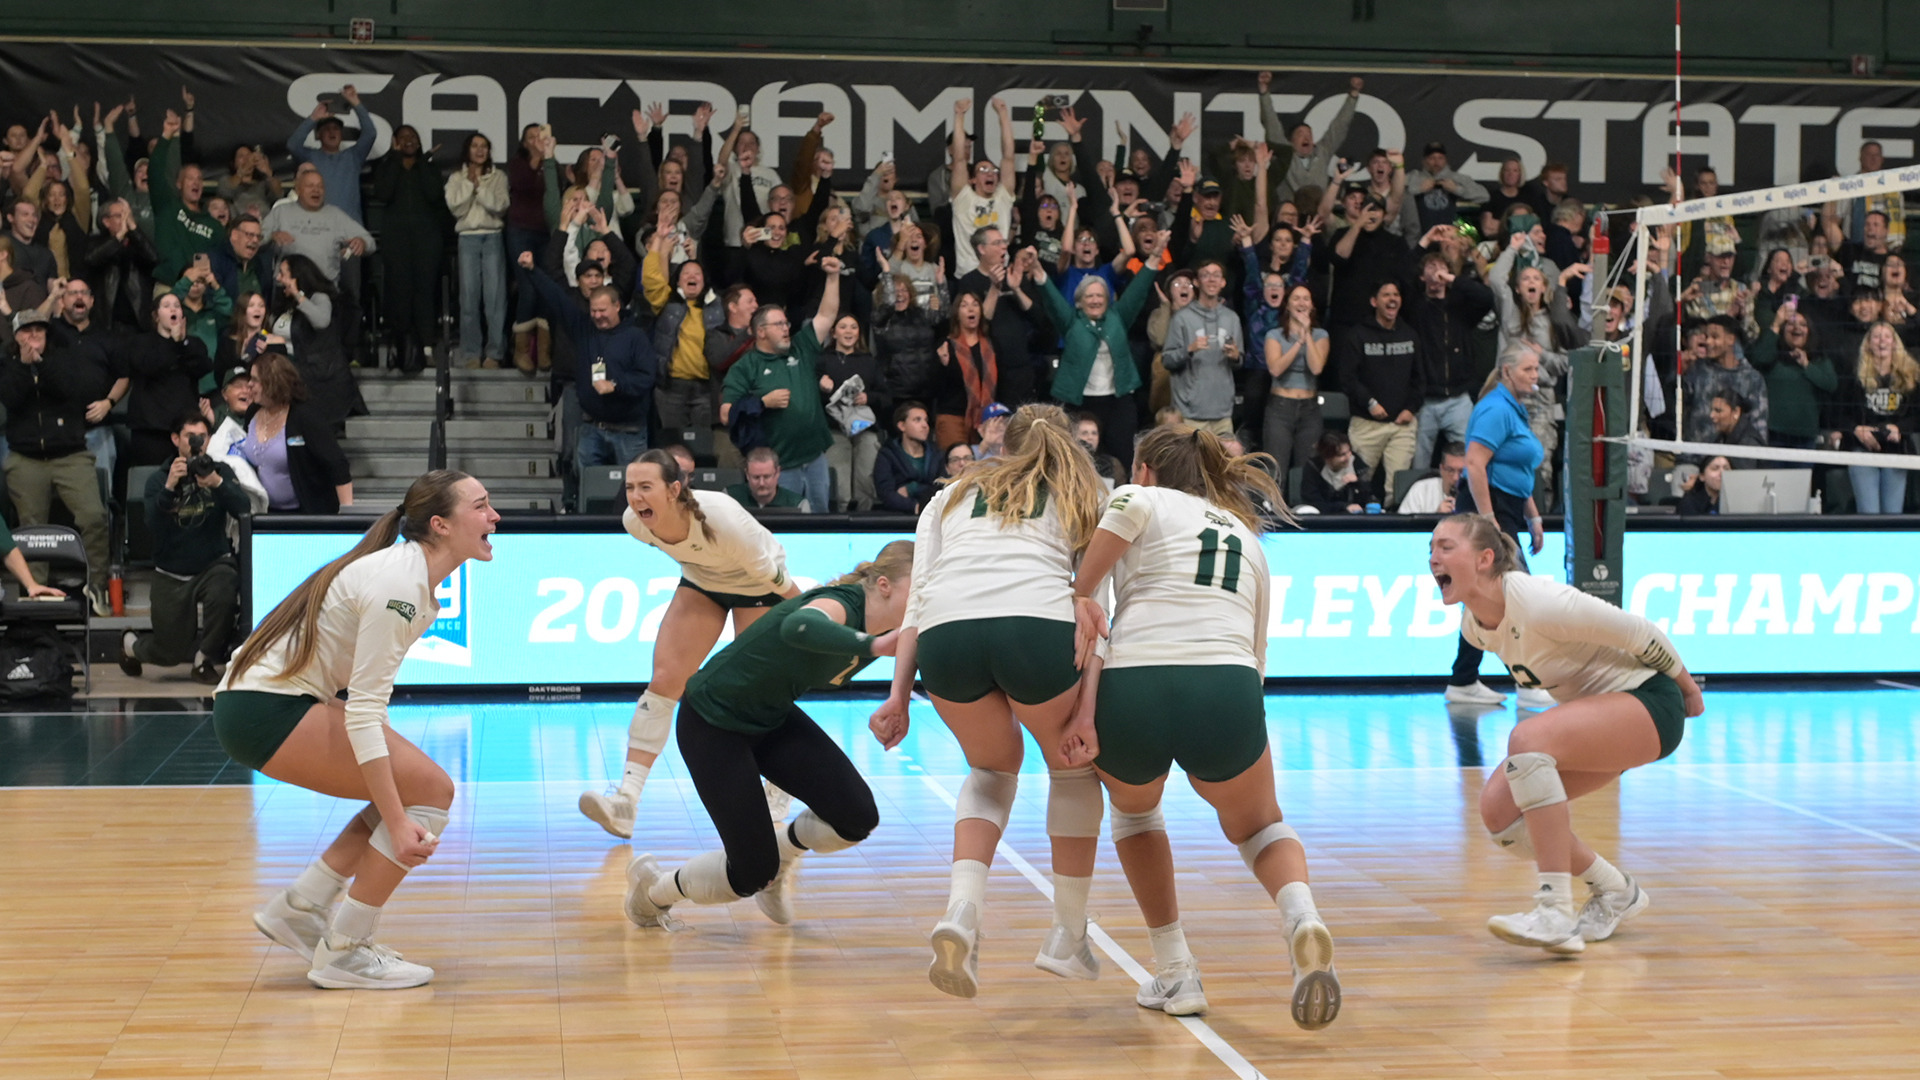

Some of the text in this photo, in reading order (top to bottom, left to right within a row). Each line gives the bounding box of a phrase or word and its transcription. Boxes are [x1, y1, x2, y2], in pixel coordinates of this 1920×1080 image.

[287, 72, 1920, 187] SACRAMENTO STATE
[1195, 527, 1243, 593] 11
[1630, 573, 1920, 635] CHAMP
